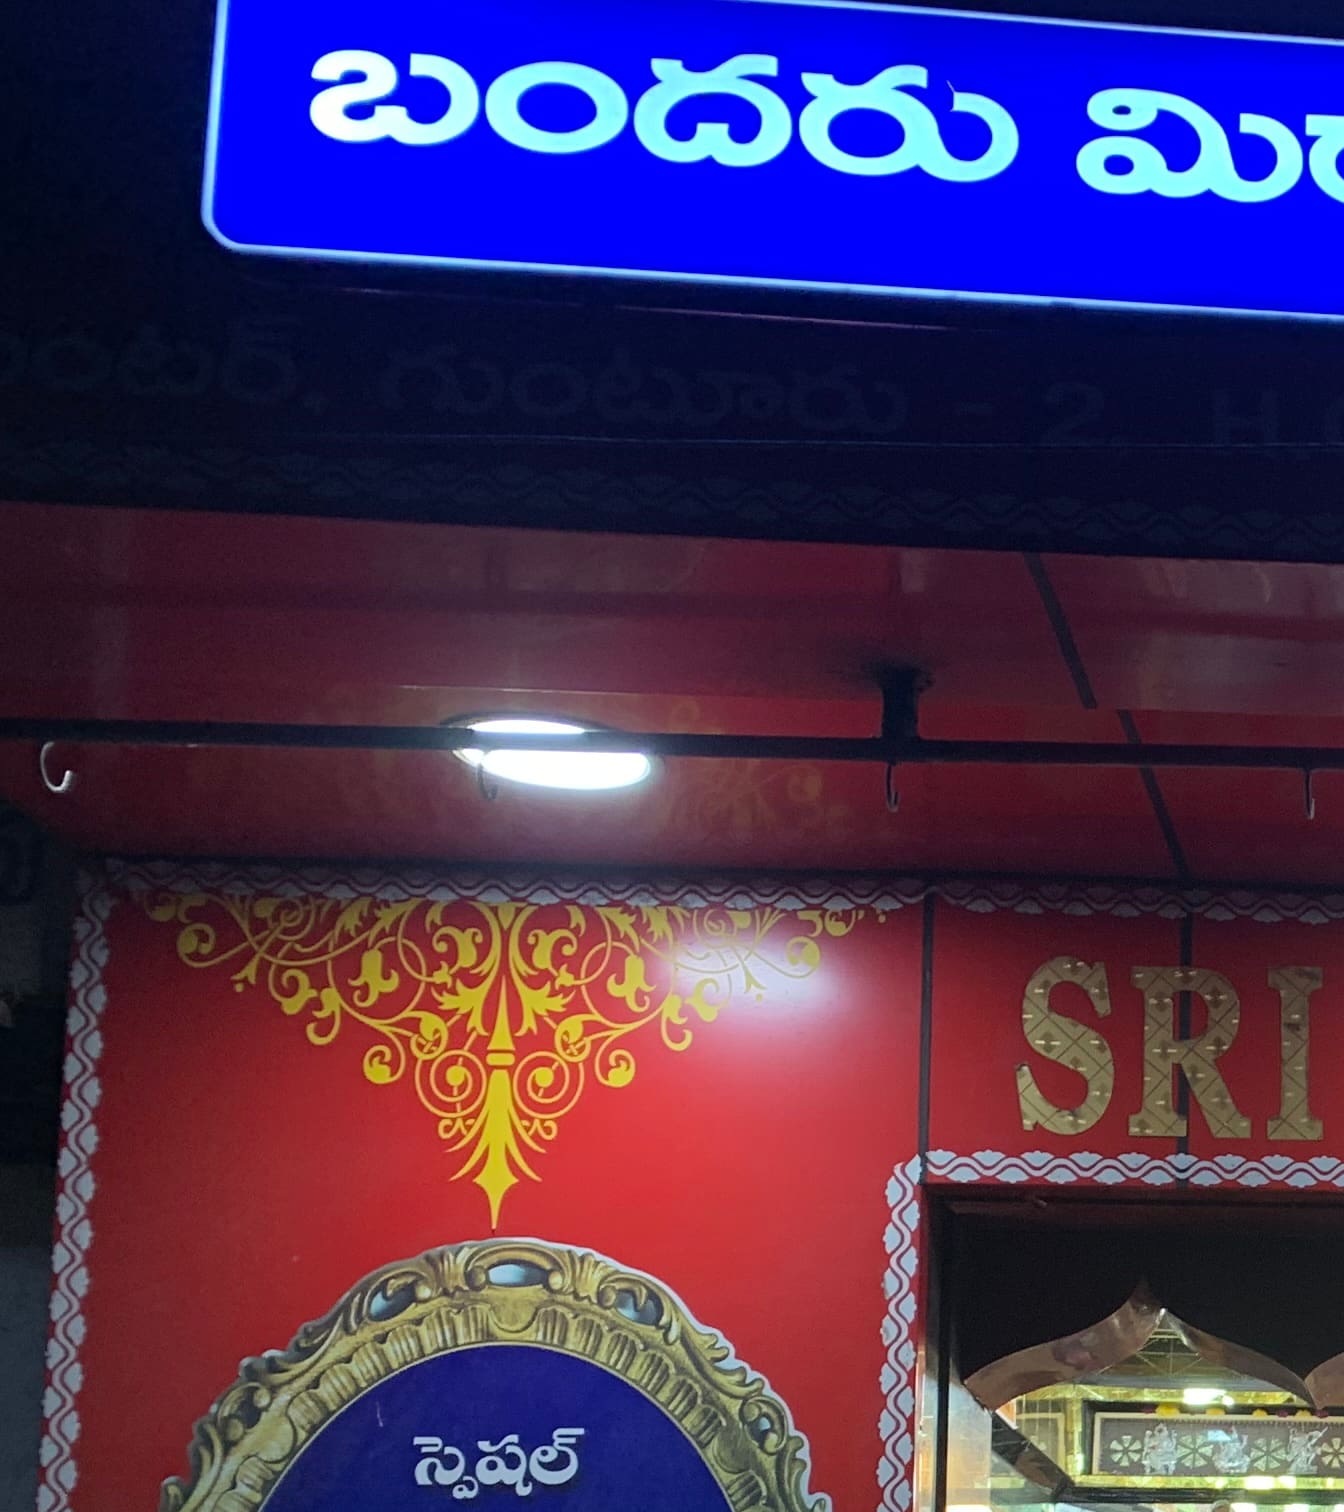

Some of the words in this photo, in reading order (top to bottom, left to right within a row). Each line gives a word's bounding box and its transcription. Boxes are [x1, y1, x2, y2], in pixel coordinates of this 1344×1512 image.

[310, 50, 1019, 182] బందరు
[1016, 955, 1324, 1140] SRI
[413, 1427, 585, 1500] స్పెషల్
